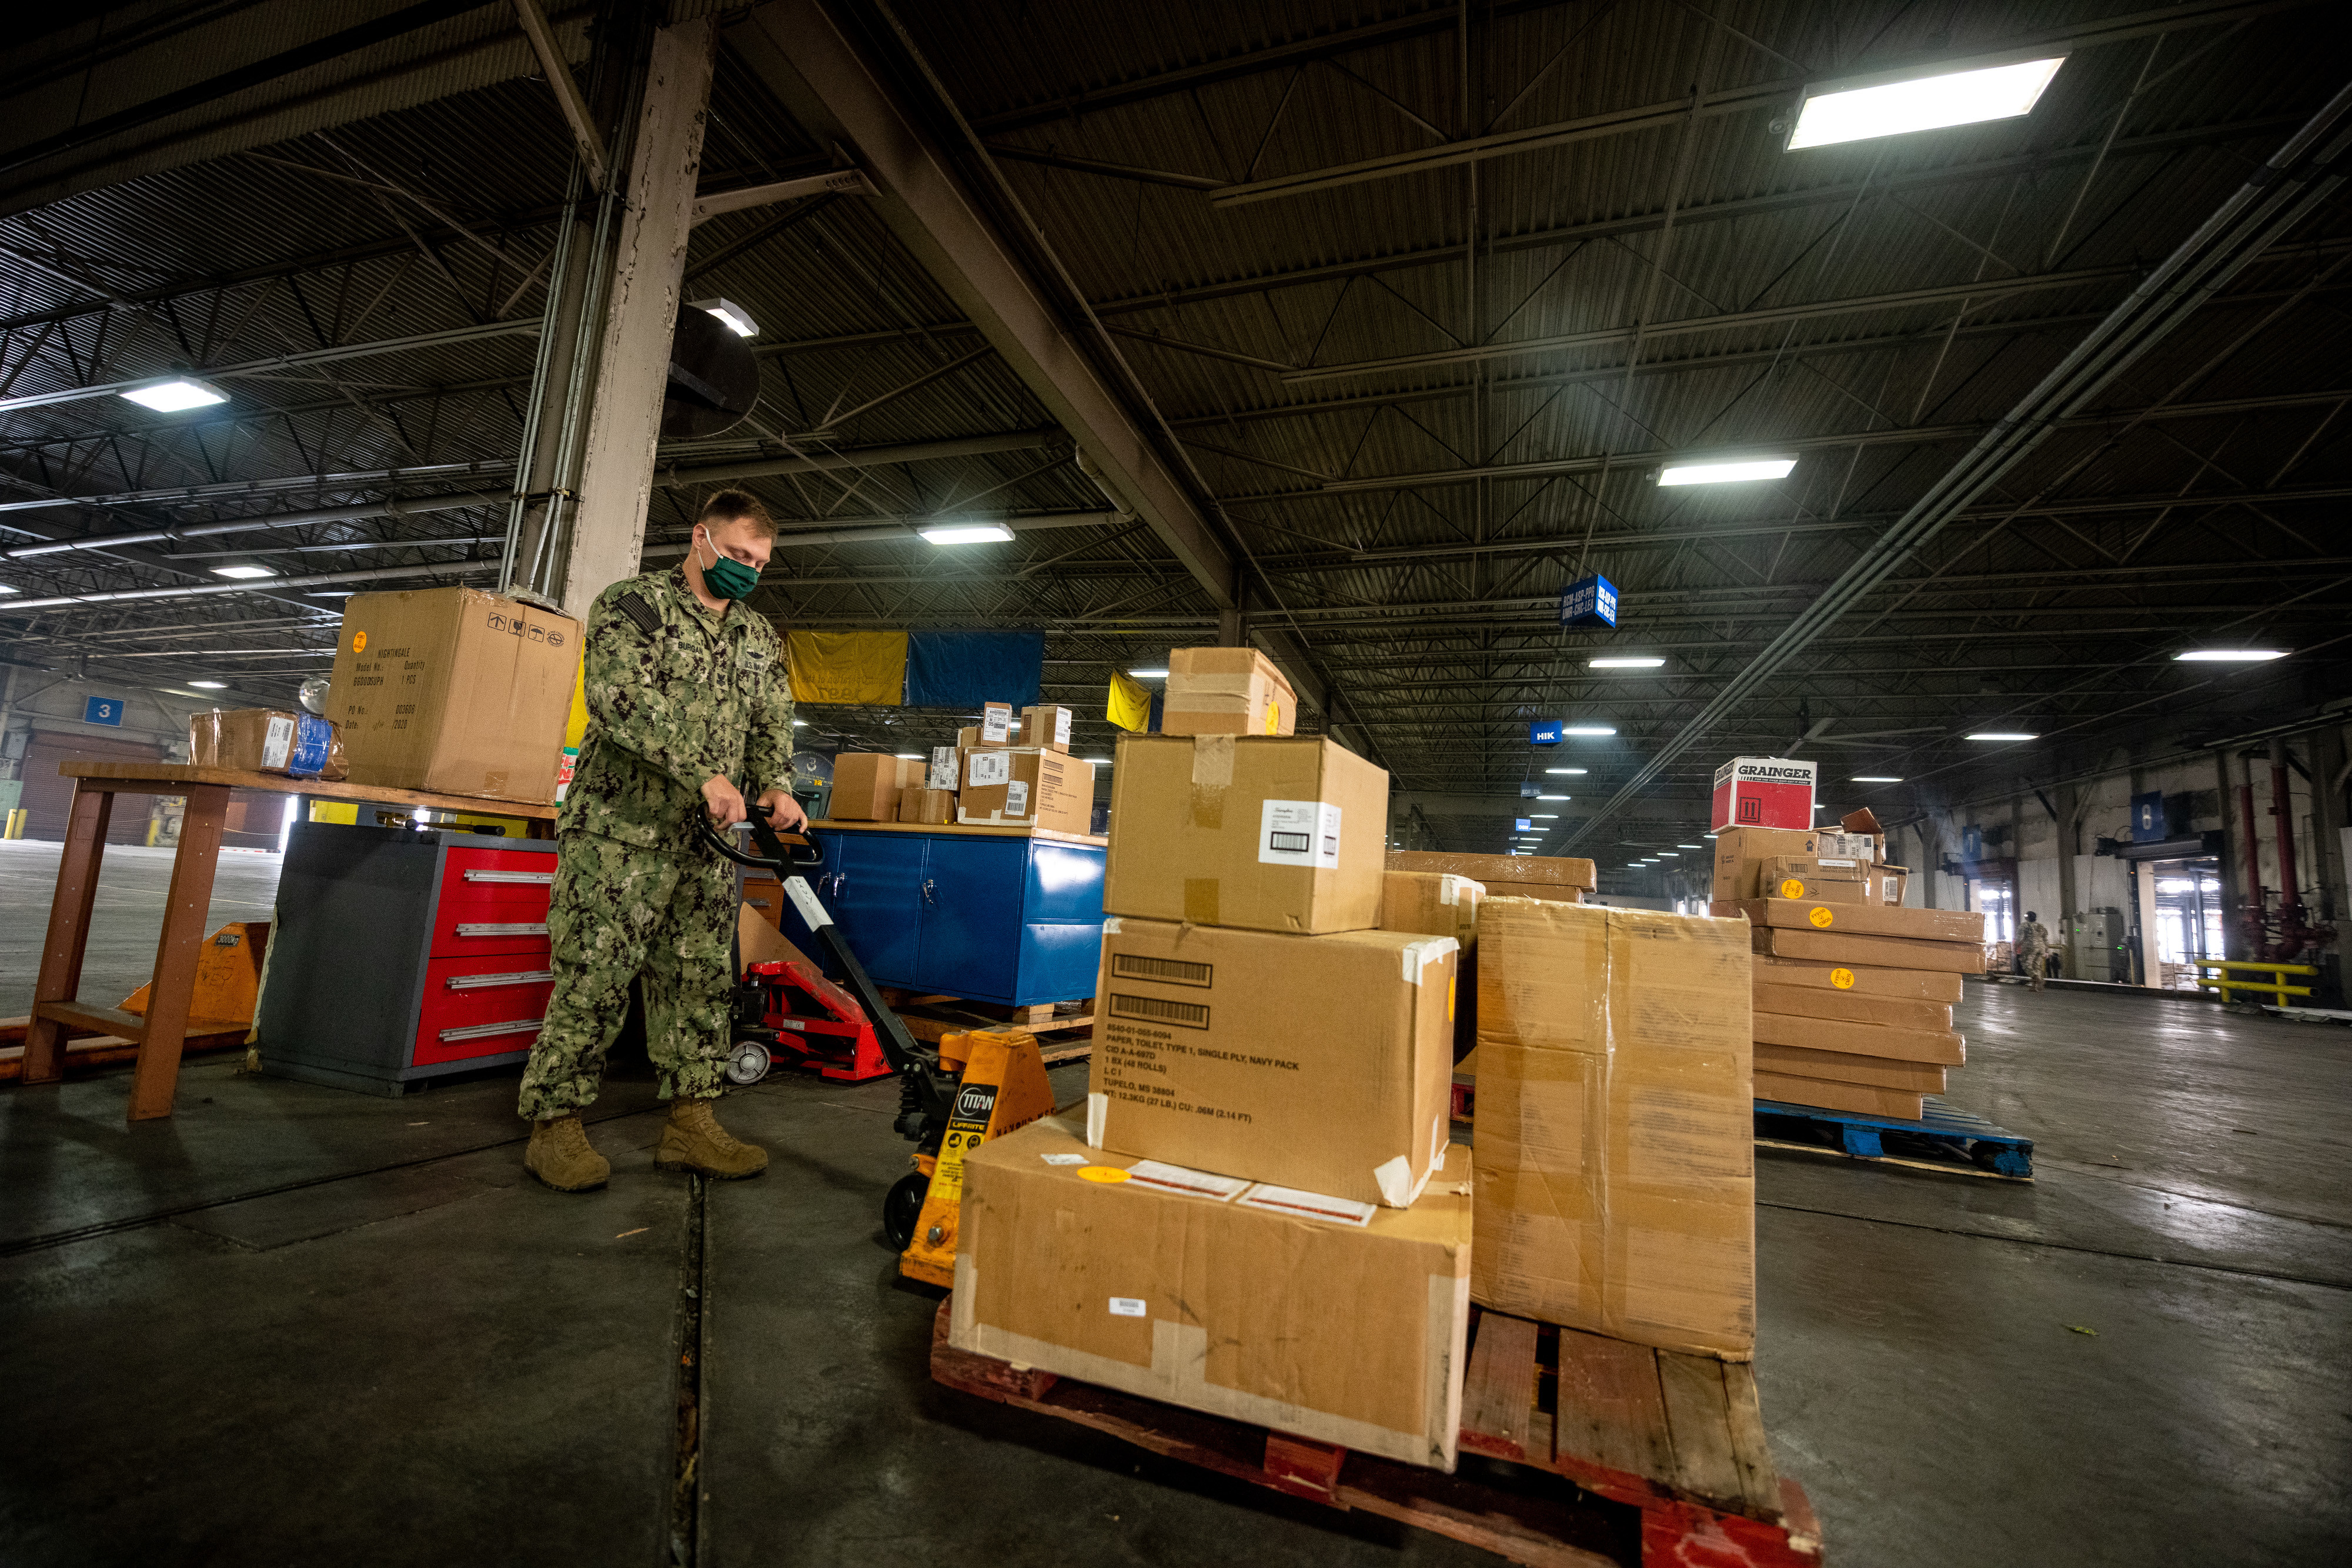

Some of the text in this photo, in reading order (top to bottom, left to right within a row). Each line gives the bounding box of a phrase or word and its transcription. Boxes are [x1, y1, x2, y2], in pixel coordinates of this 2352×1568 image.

[1563, 586, 1595, 607] RCM-ASP-PPG
[1562, 599, 1593, 620] UMR-CHC-LEA
[377, 648, 410, 658] NIGHTINGALE
[678, 641, 703, 656] BURGAN
[356, 663, 383, 671] Model No.:
[405, 660, 425, 671] Quantity
[744, 661, 753, 670] U.S.
[402, 675, 416, 684] 1 PCS
[99, 704, 111, 718] 3
[348, 706, 368, 715] PO No.:
[396, 705, 415, 714] 003606
[345, 720, 359, 729] Date:
[1537, 732, 1555, 740] HIK
[1738, 765, 1811, 779] GRAINGER
[2142, 804, 2151, 830] 8
[1811, 908, 1826, 919] FY9150
[1819, 917, 1832, 926] CMOS
[218, 935, 239, 945] 3000kg
[1105, 1045, 1119, 1054] CID
[1106, 1034, 1299, 1071] PAPER, TOILET, TYPE 1, SINGLE PLY, NAVY PACK
[1111, 1057, 1122, 1065] BX
[1137, 1061, 1167, 1075] ROLLS)
[1104, 1077, 1136, 1091] TUPELO,
[1138, 1084, 1150, 1094] MS
[963, 1093, 994, 1111] TITAN
[1238, 1112, 1252, 1124] FT)
